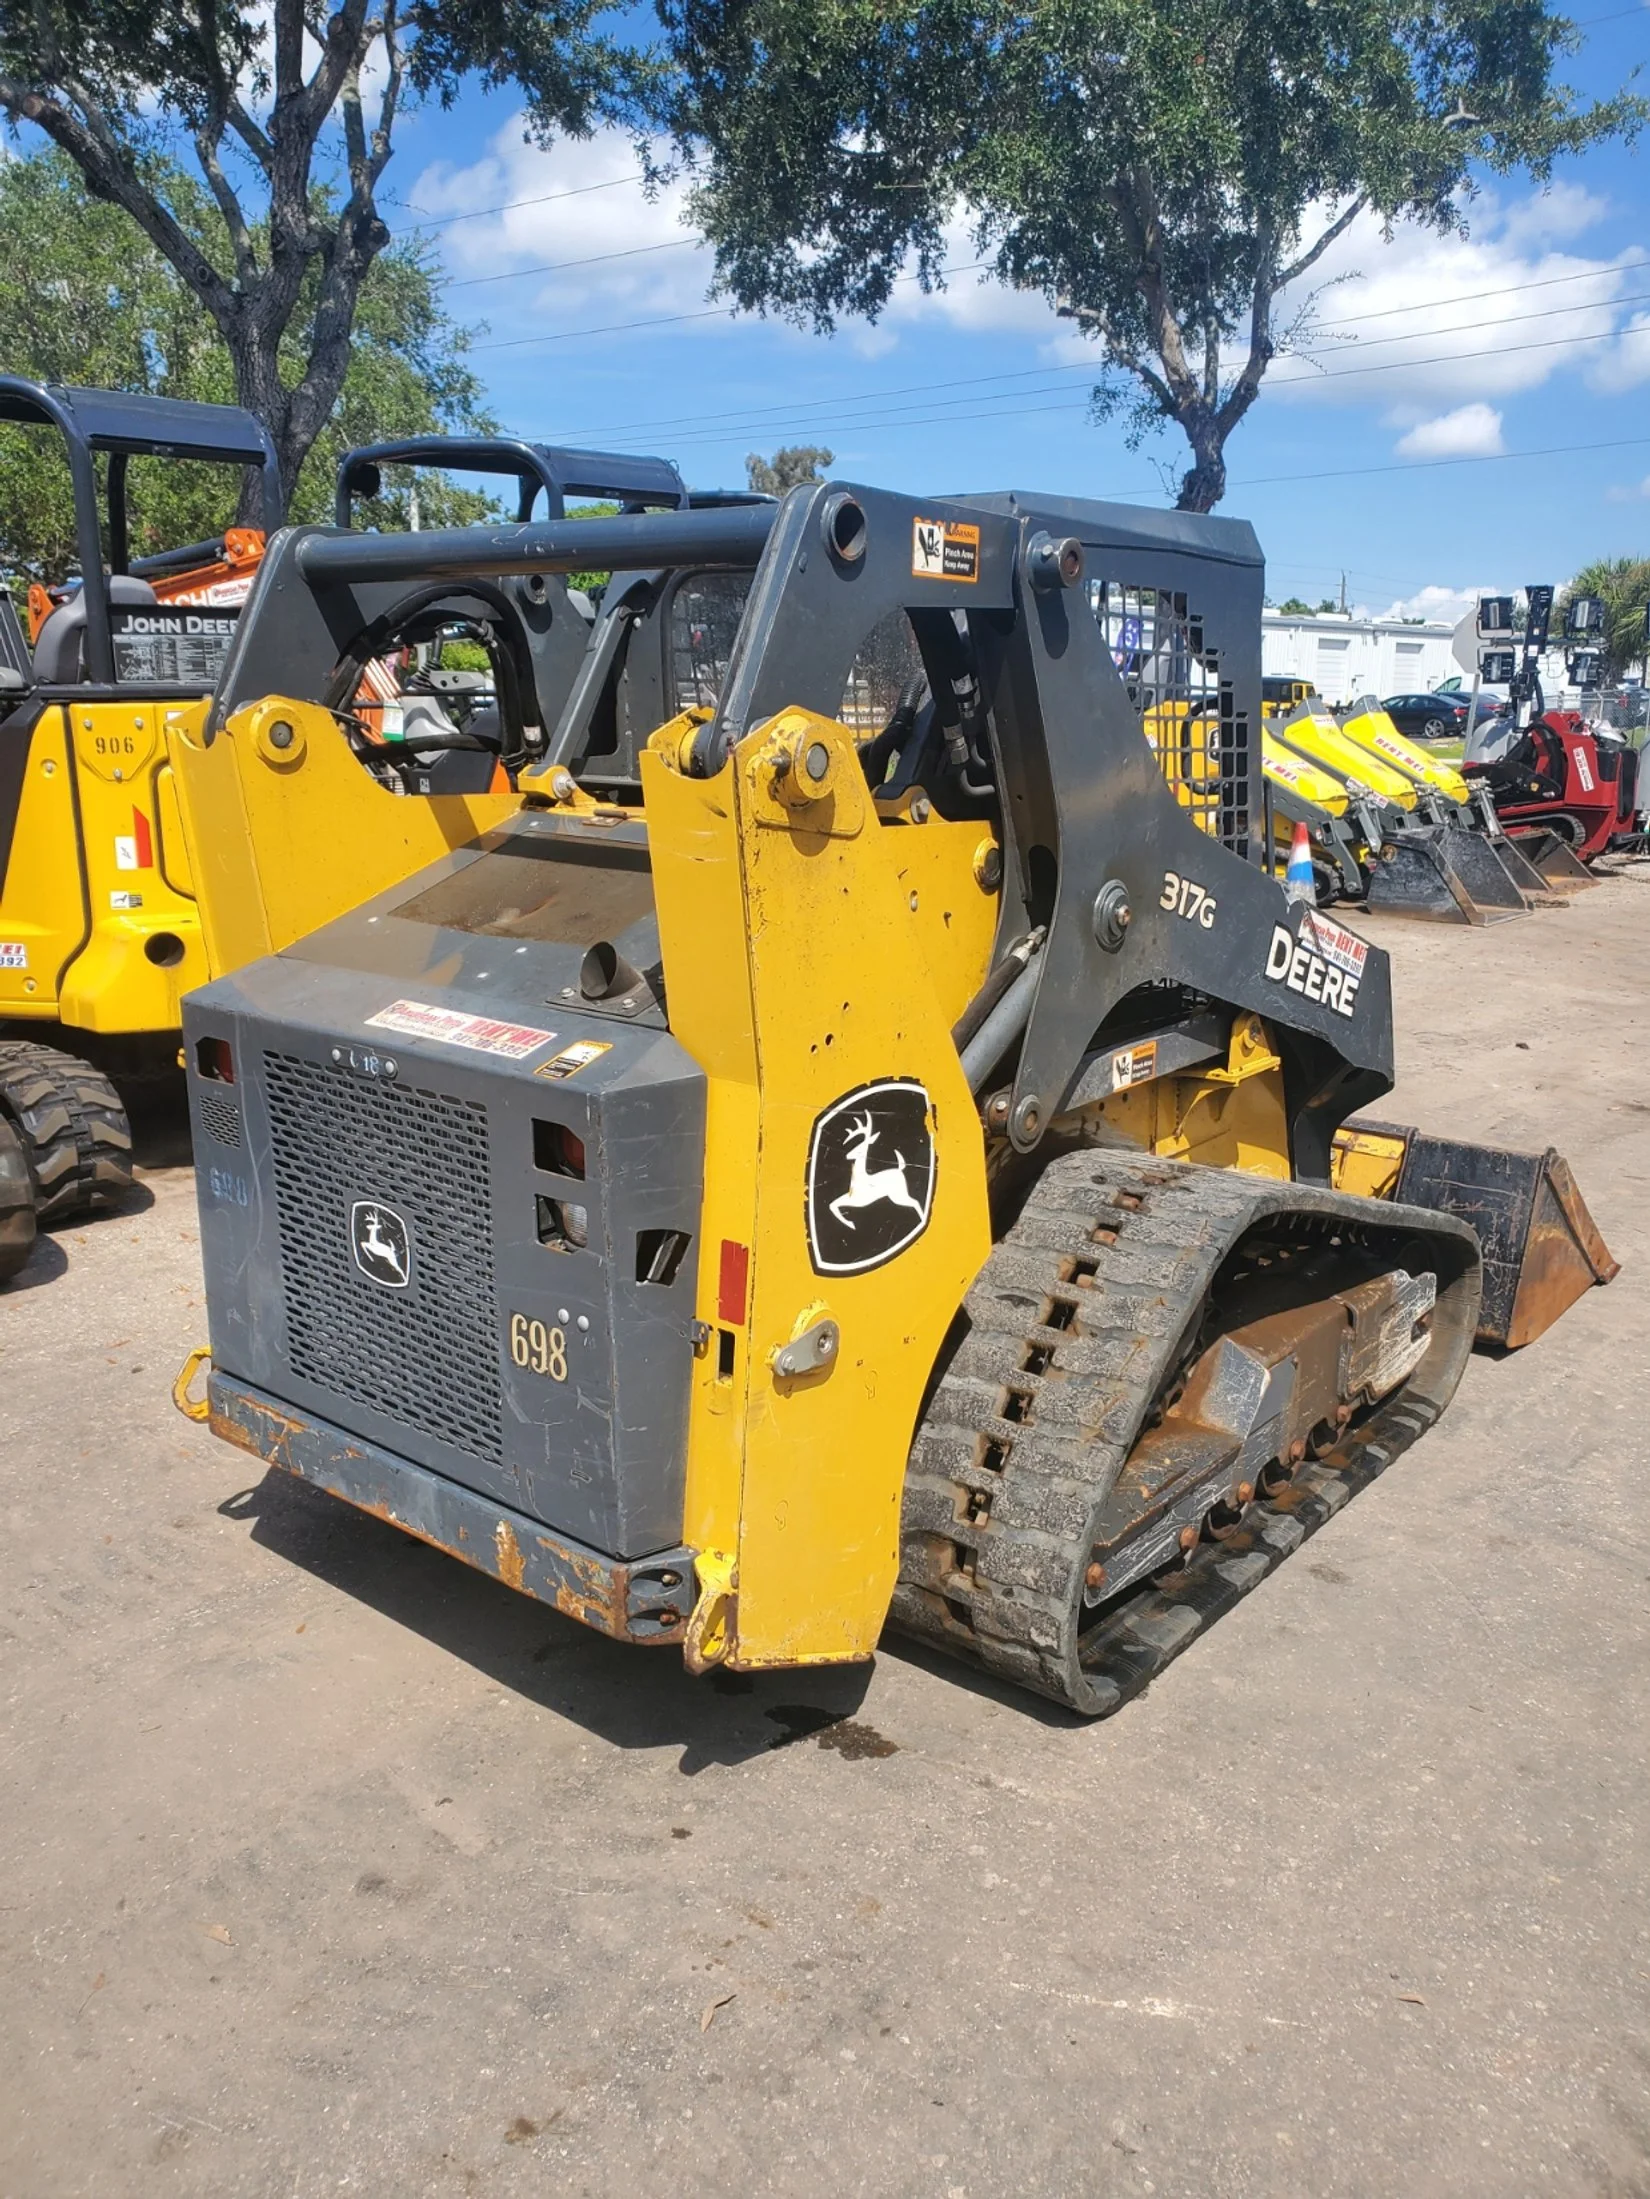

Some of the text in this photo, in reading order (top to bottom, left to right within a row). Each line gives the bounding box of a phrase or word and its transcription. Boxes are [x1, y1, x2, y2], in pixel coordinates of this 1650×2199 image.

[944, 546, 974, 560] Pinch Area
[121, 614, 182, 634] JOHN
[95, 736, 134, 754] 906
[1375, 738, 1403, 756] RENT
[1159, 872, 1217, 929] 317G
[1264, 925, 1360, 1017] DEERE
[511, 1313, 568, 1382] 698
